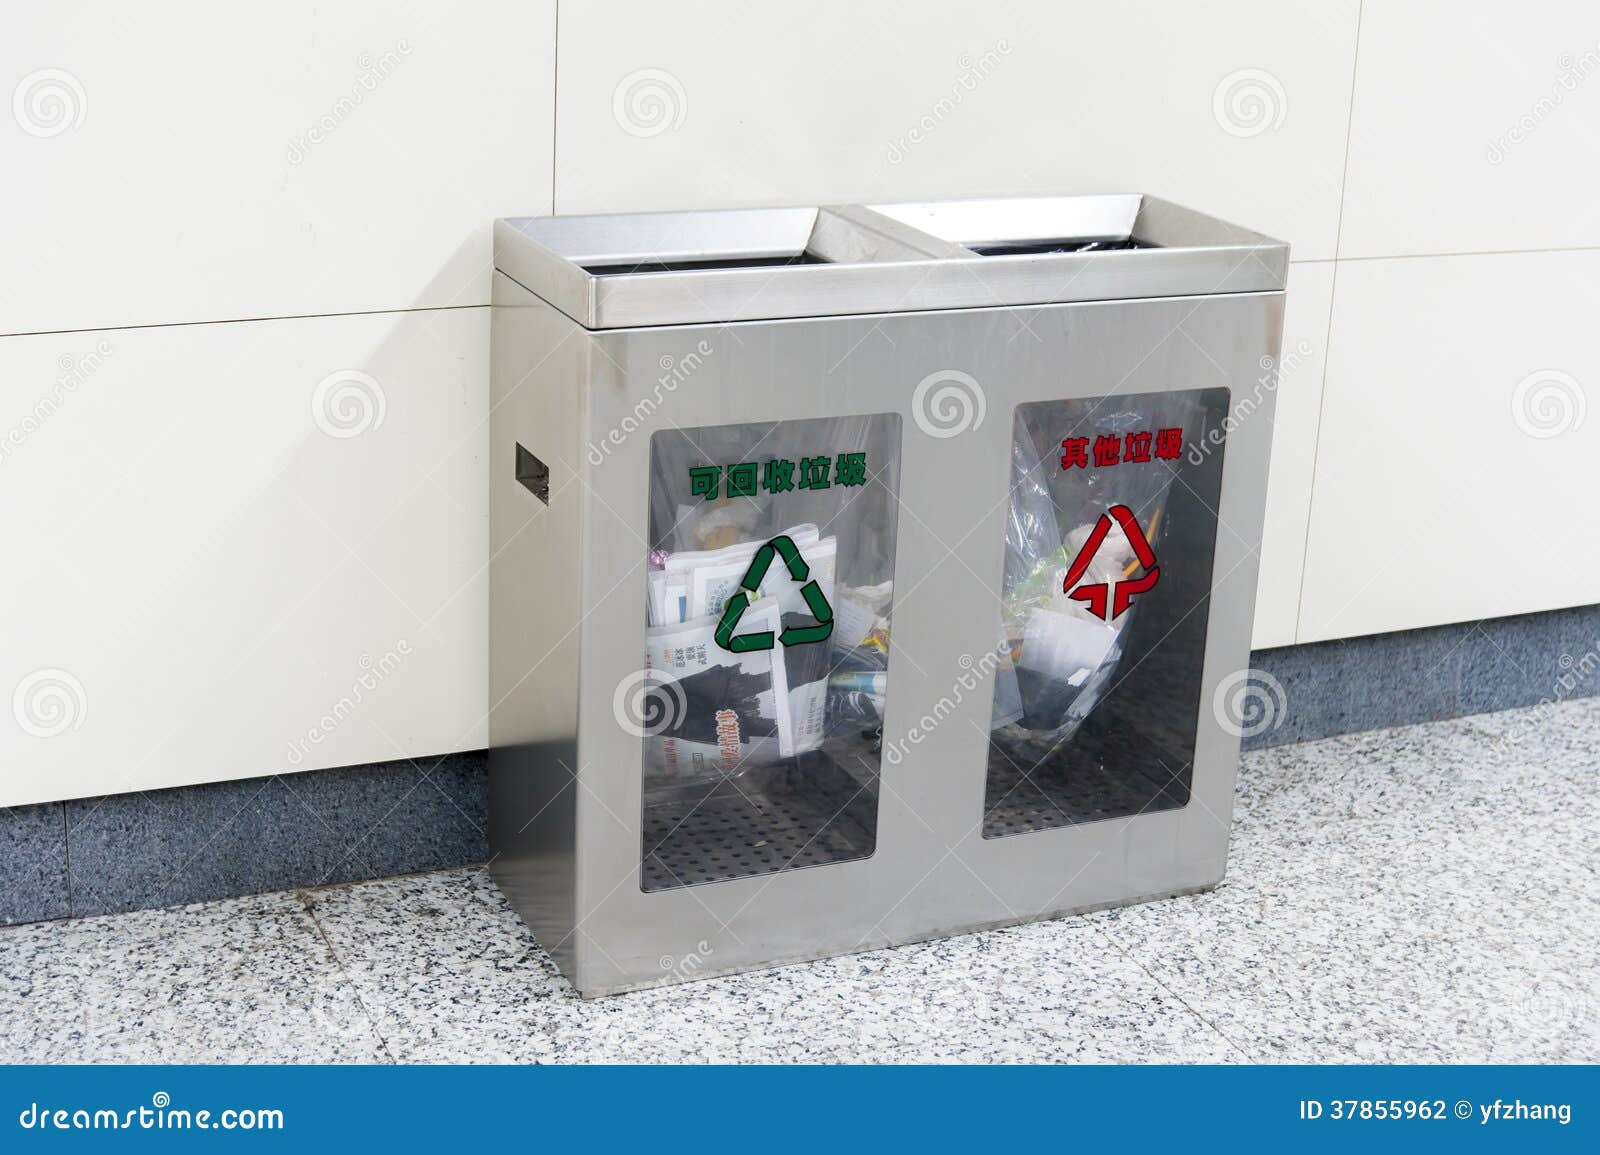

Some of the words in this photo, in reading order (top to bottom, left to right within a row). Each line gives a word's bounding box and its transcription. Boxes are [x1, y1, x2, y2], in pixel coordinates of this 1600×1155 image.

[1061, 428, 1182, 470] 其他垃圾
[689, 452, 866, 500] 可回收垃圾
